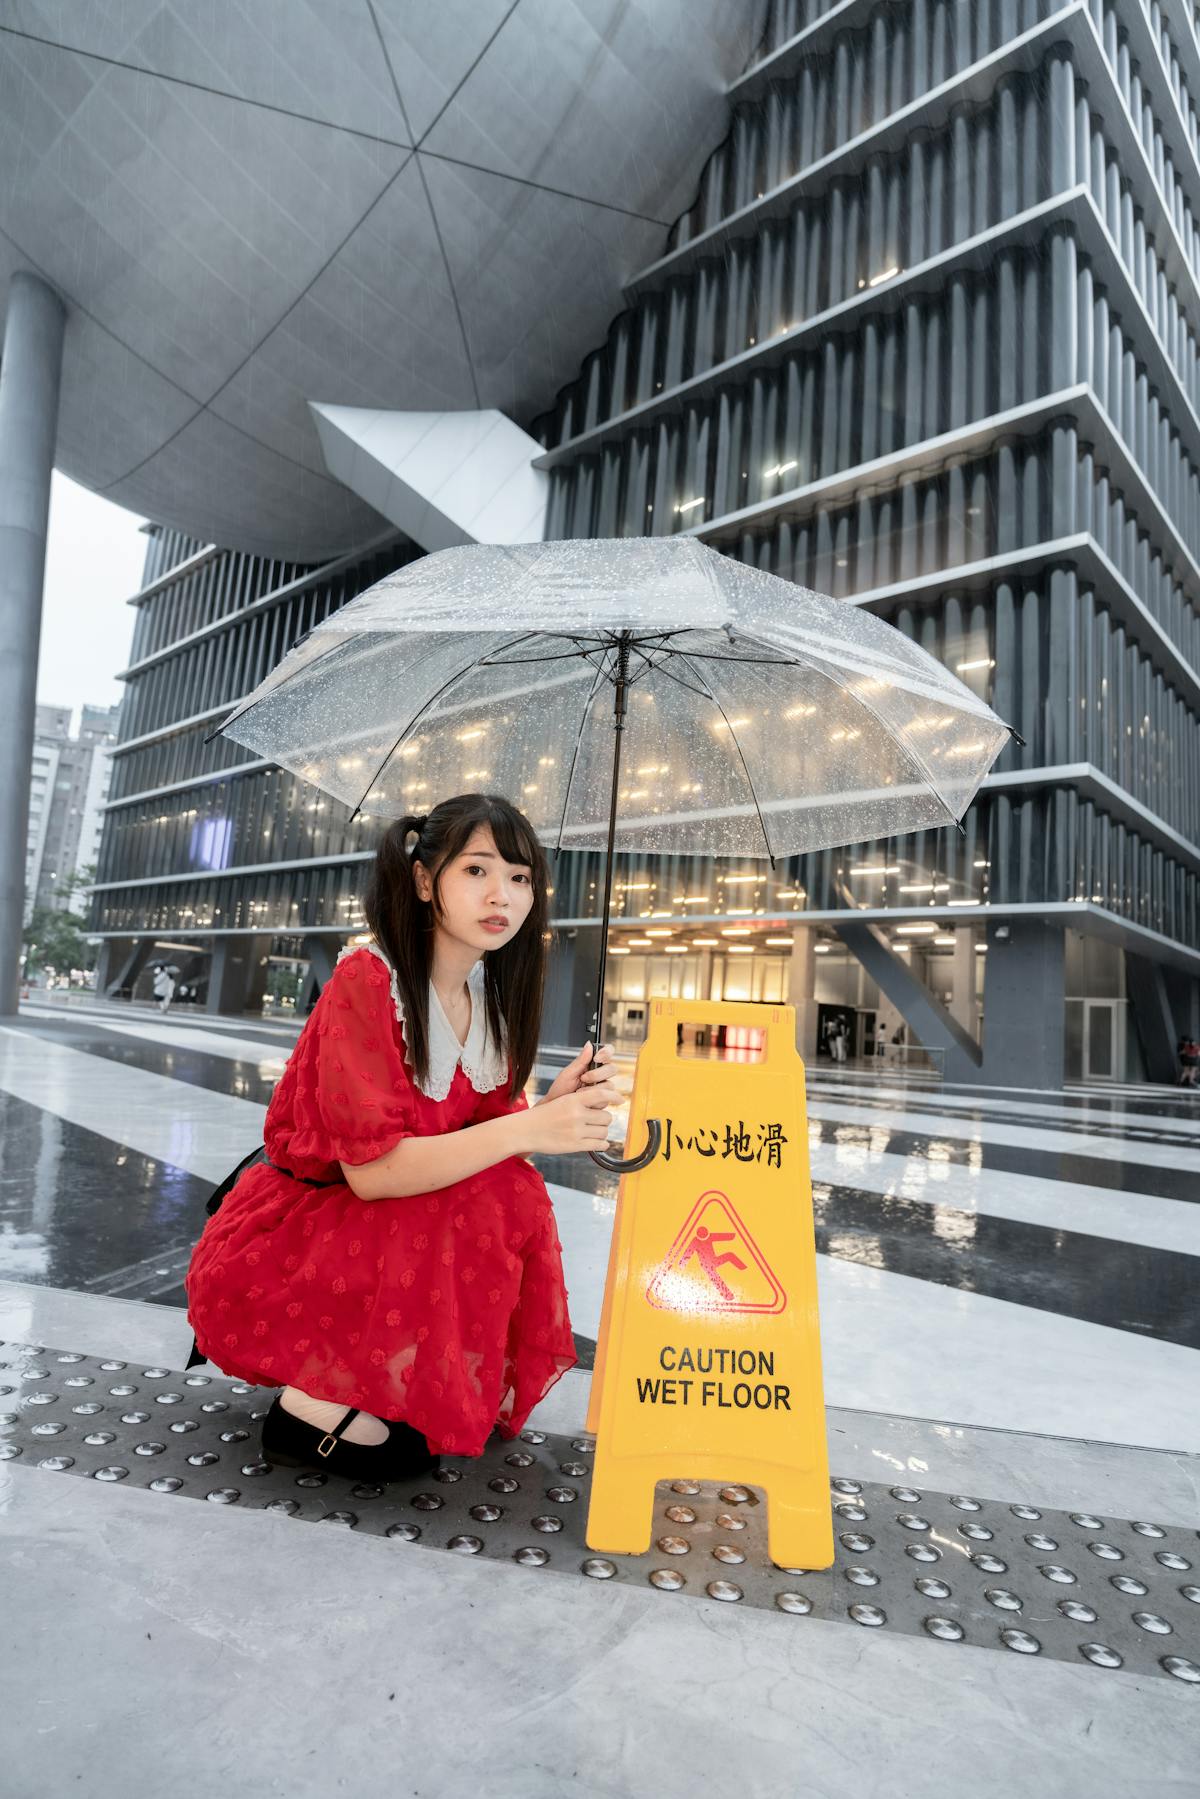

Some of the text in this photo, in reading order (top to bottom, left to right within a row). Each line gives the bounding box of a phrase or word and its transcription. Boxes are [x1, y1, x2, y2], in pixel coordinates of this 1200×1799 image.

[660, 1118, 789, 1169] 小心地滑
[659, 1346, 774, 1376] CAUTION
[636, 1377, 792, 1411] WET FLOOR
